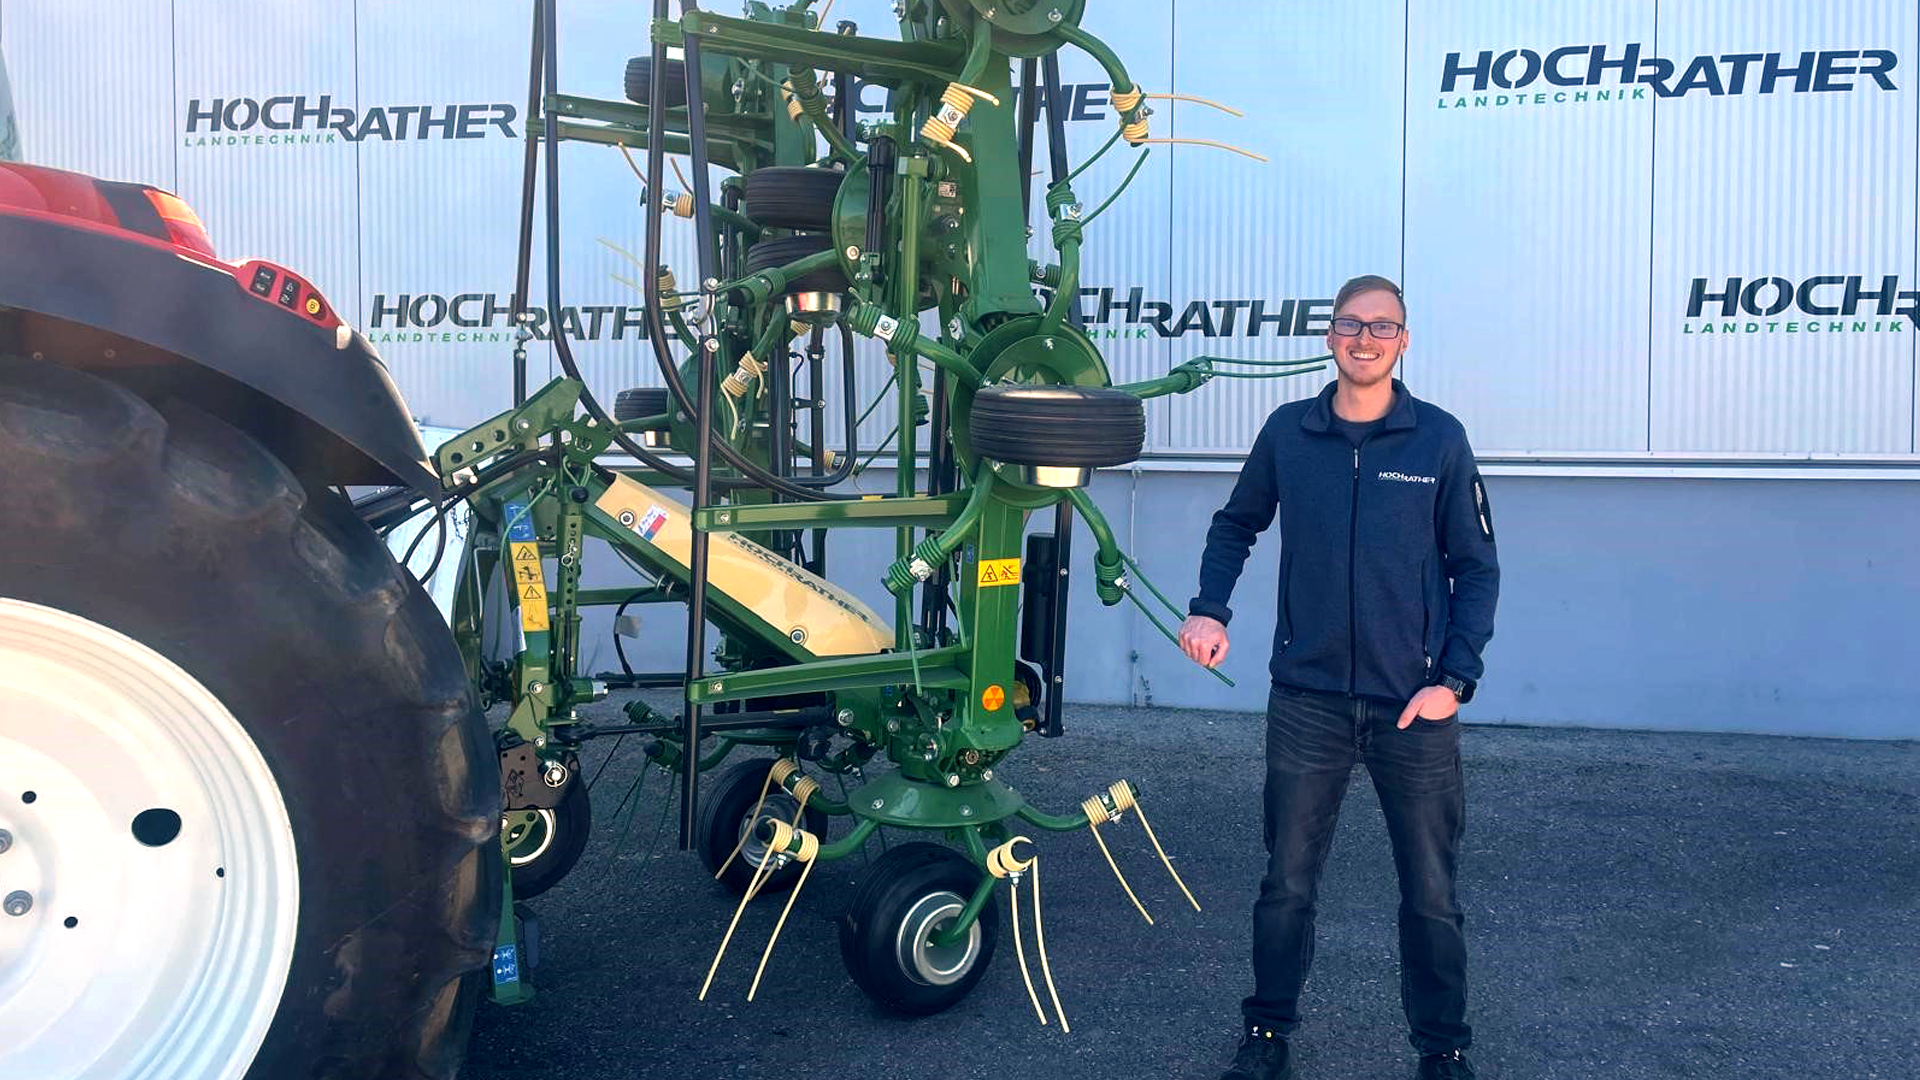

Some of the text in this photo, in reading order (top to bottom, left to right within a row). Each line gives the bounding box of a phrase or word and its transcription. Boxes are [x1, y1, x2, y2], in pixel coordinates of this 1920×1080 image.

[1440, 43, 1899, 98] HOCHRATHER
[1438, 88, 1646, 109] LANDTECHNIK
[186, 95, 518, 142] HOCHRATHER
[184, 133, 336, 147] LANDTECHNIK
[1683, 321, 1903, 334] LANDTECHNIK
[368, 331, 513, 343] LANDTECHNI
